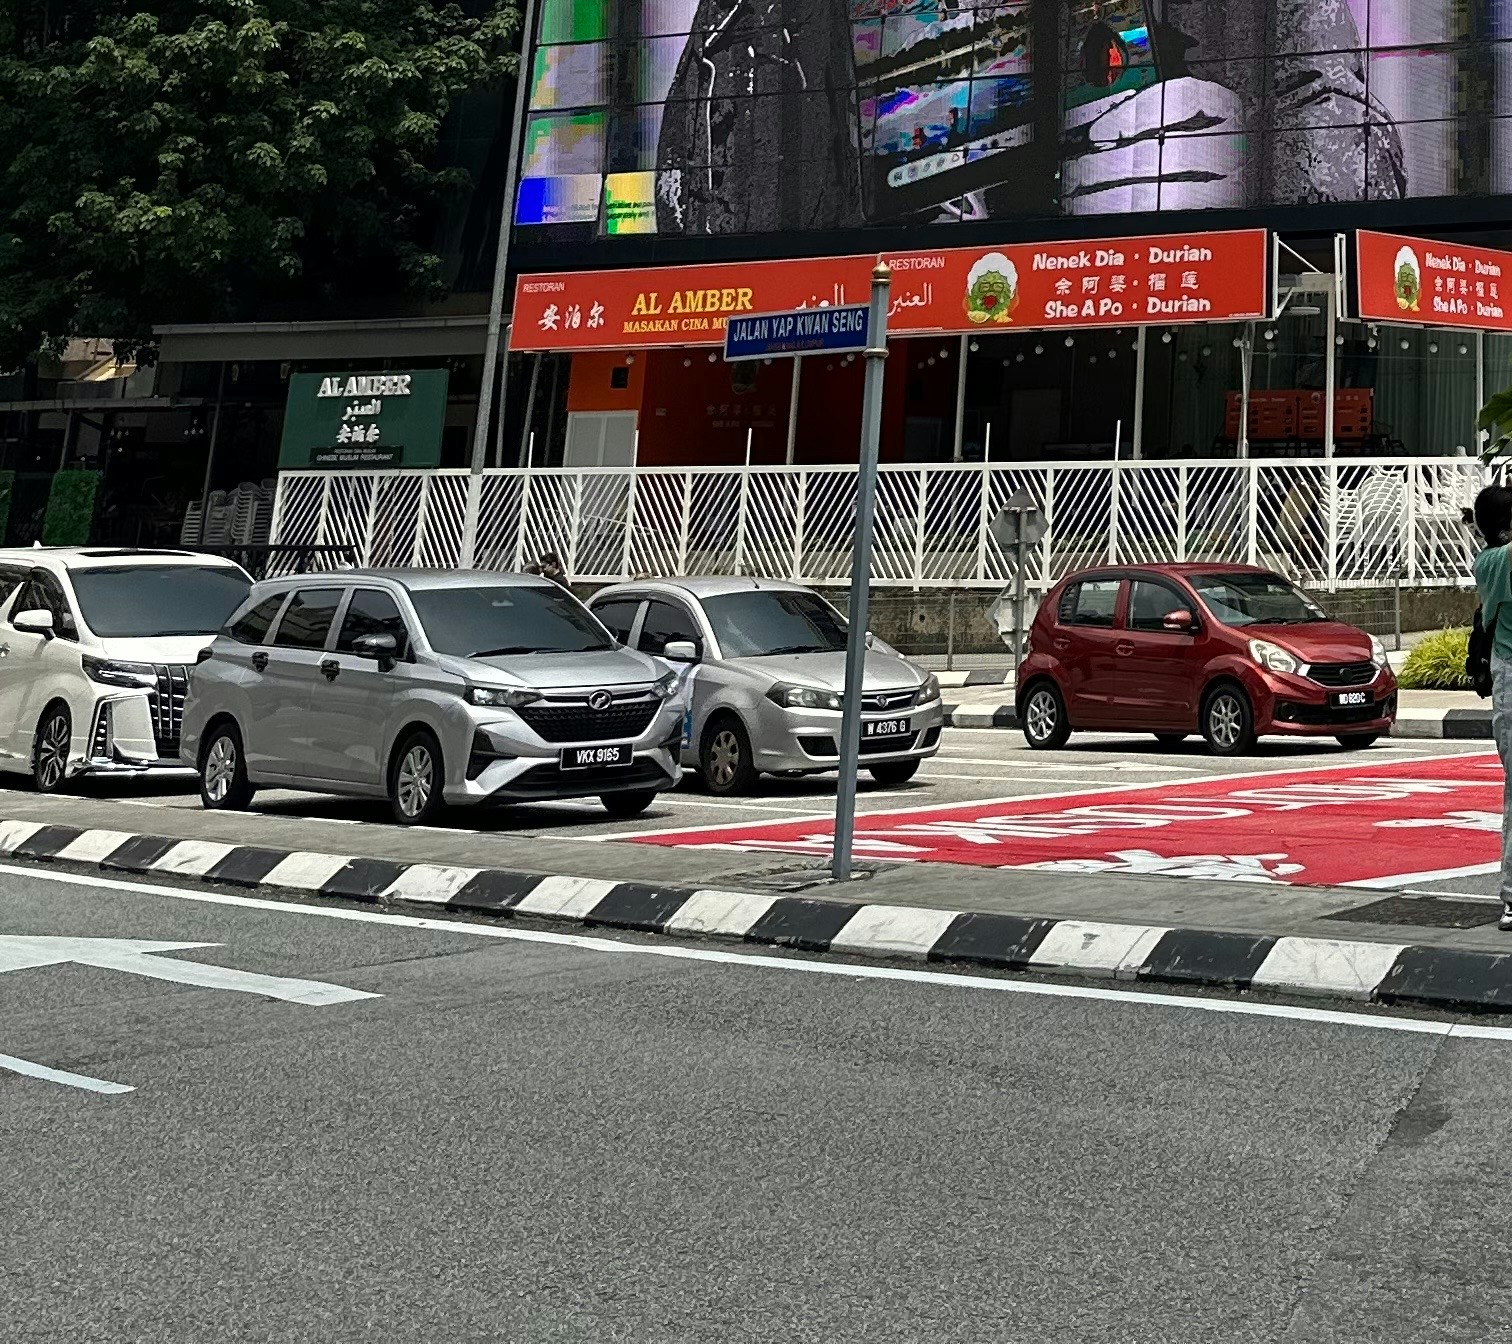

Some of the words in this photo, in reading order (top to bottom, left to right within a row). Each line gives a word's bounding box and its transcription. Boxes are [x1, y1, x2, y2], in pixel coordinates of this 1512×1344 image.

[889, 257, 945, 271] RESTORAN
[1032, 251, 1092, 271] Nenek
[1095, 249, 1125, 267] Dia
[1149, 244, 1212, 263] Durian
[1425, 252, 1451, 270] Nenek
[1452, 256, 1466, 272] Dia
[1474, 259, 1501, 277] Durian
[523, 282, 565, 293] RESTORAN
[886, 282, 932, 317] العنبر
[631, 292, 663, 316] AL
[667, 287, 754, 313] AMBER
[1044, 300, 1078, 319] She
[1081, 299, 1096, 316] A
[1099, 297, 1123, 316] Po
[1147, 295, 1211, 314] Durian
[1433, 296, 1448, 313] She
[1449, 298, 1457, 314] A
[1457, 298, 1468, 315] Po
[1476, 301, 1503, 318] Durian
[537, 300, 605, 331] 安泊尔
[622, 320, 678, 333] MASAKAN
[681, 318, 709, 331] CINA
[733, 319, 769, 342] JALAN
[772, 317, 794, 338] YAP
[796, 313, 829, 336] KWAN
[832, 310, 864, 333] SENG
[317, 377, 344, 398] AL
[343, 374, 412, 397] AMBER
[867, 722, 875, 735] W
[876, 720, 898, 734] 4376
[577, 749, 596, 763] VKX
